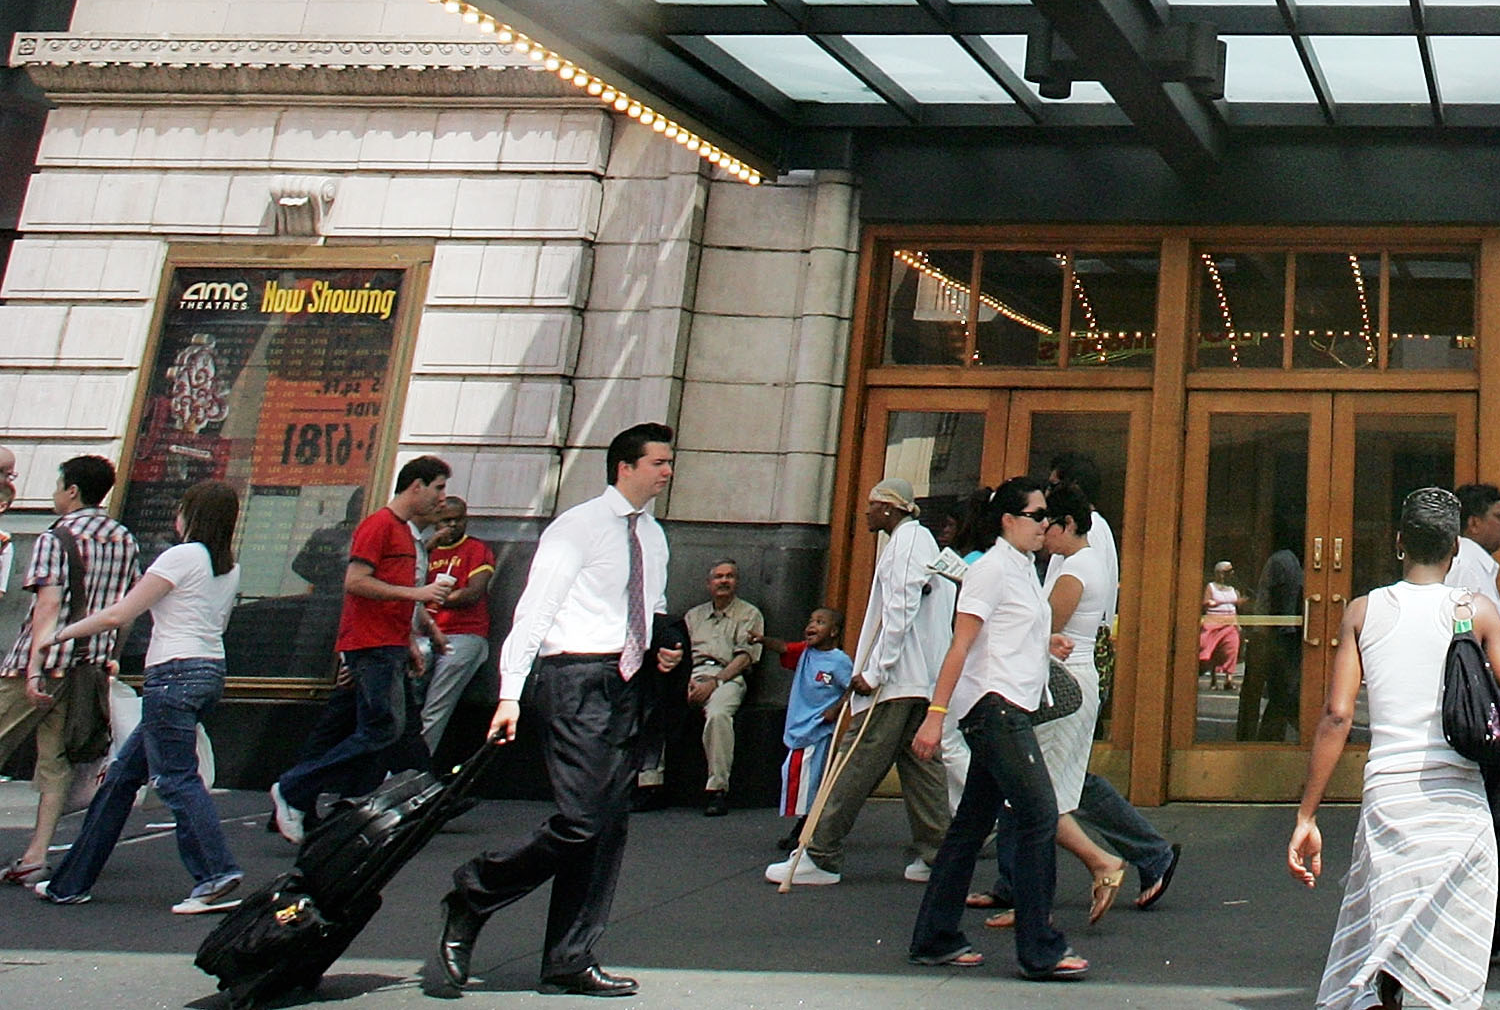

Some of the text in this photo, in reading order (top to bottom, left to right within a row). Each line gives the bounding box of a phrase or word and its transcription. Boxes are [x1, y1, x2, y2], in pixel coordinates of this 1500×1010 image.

[179, 301, 248, 310] THEATRES
[261, 280, 396, 321] Now Showing
